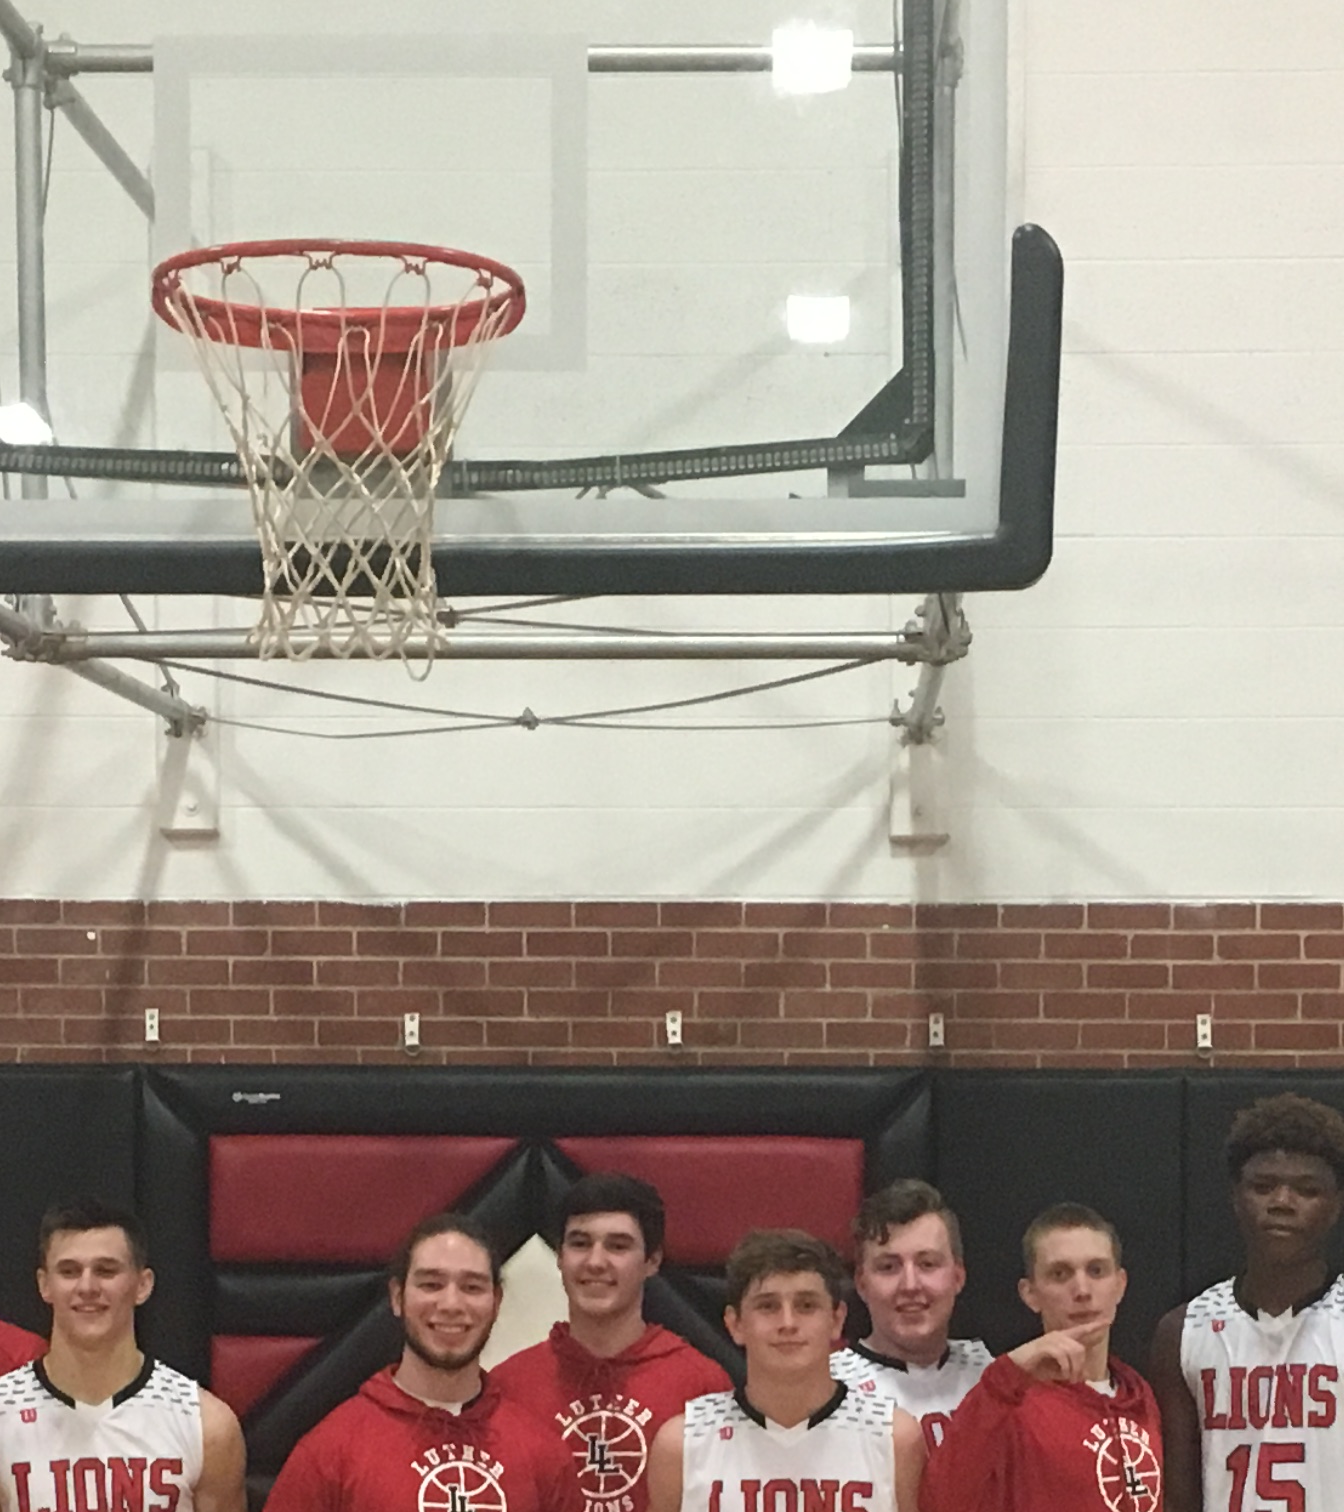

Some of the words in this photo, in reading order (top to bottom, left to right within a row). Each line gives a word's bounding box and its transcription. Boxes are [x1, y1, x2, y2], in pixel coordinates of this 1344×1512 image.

[1201, 1363, 1338, 1430] LIONS
[1083, 1417, 1150, 1452] LUHER
[410, 1443, 504, 1480] LUTHER
